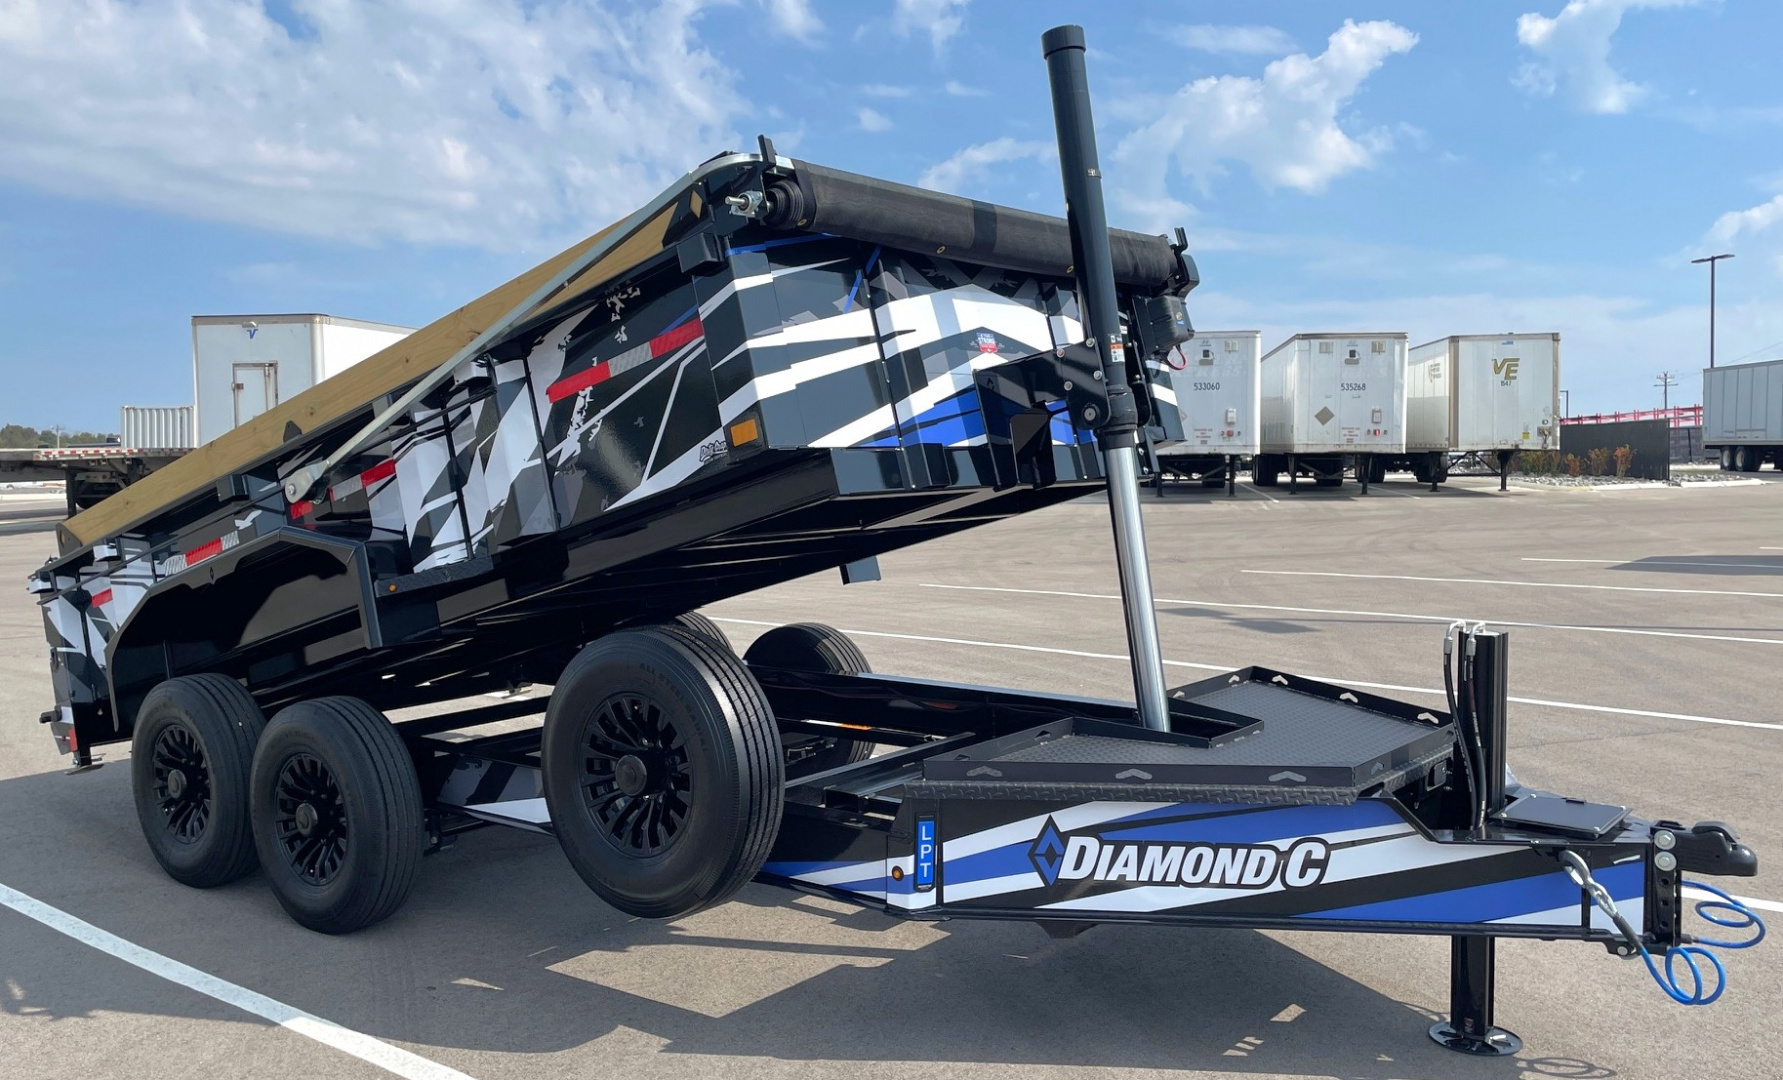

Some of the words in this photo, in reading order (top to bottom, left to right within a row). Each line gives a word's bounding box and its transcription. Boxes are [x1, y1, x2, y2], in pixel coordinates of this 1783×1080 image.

[1491, 358, 1521, 380] VE
[1193, 382, 1221, 391] 533060
[1340, 382, 1366, 391] 535268
[919, 825, 933, 878] LPT
[1284, 840, 1325, 888] C
